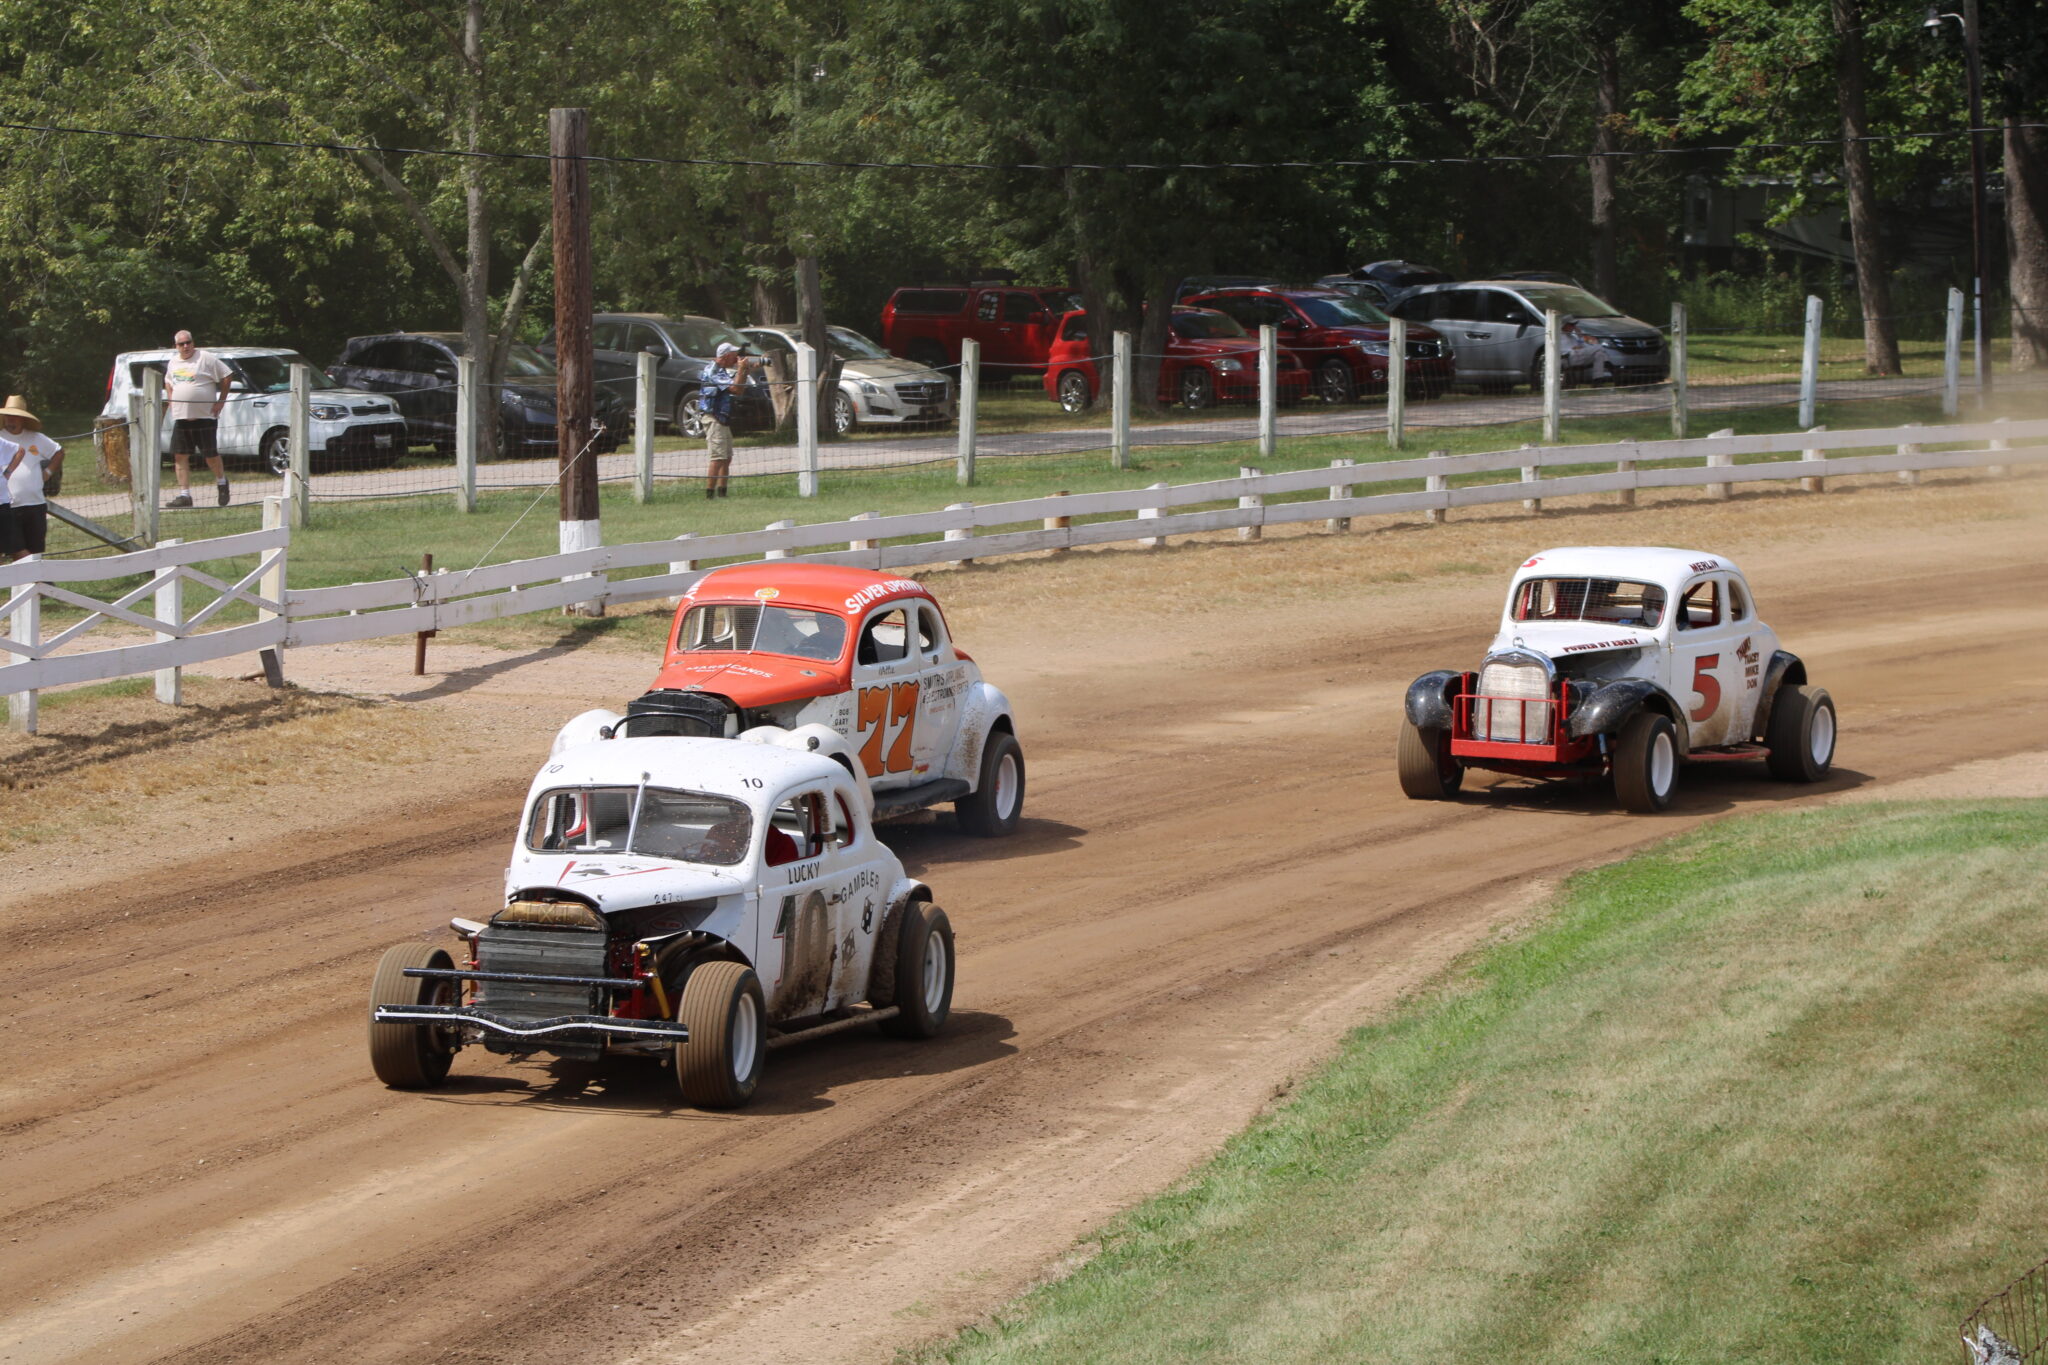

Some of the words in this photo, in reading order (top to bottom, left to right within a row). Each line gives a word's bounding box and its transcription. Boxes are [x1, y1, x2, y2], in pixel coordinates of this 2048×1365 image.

[1689, 559, 1720, 573] MERLIN
[845, 584, 889, 615] SILVER
[1690, 653, 1721, 722] 5
[1746, 679, 1757, 690] DON
[857, 679, 920, 778] 77
[740, 777, 764, 789] 10
[788, 861, 820, 885] LUCKY
[840, 869, 880, 904] GAMBLER
[654, 892, 673, 905] 247
[772, 887, 830, 1000] 10
